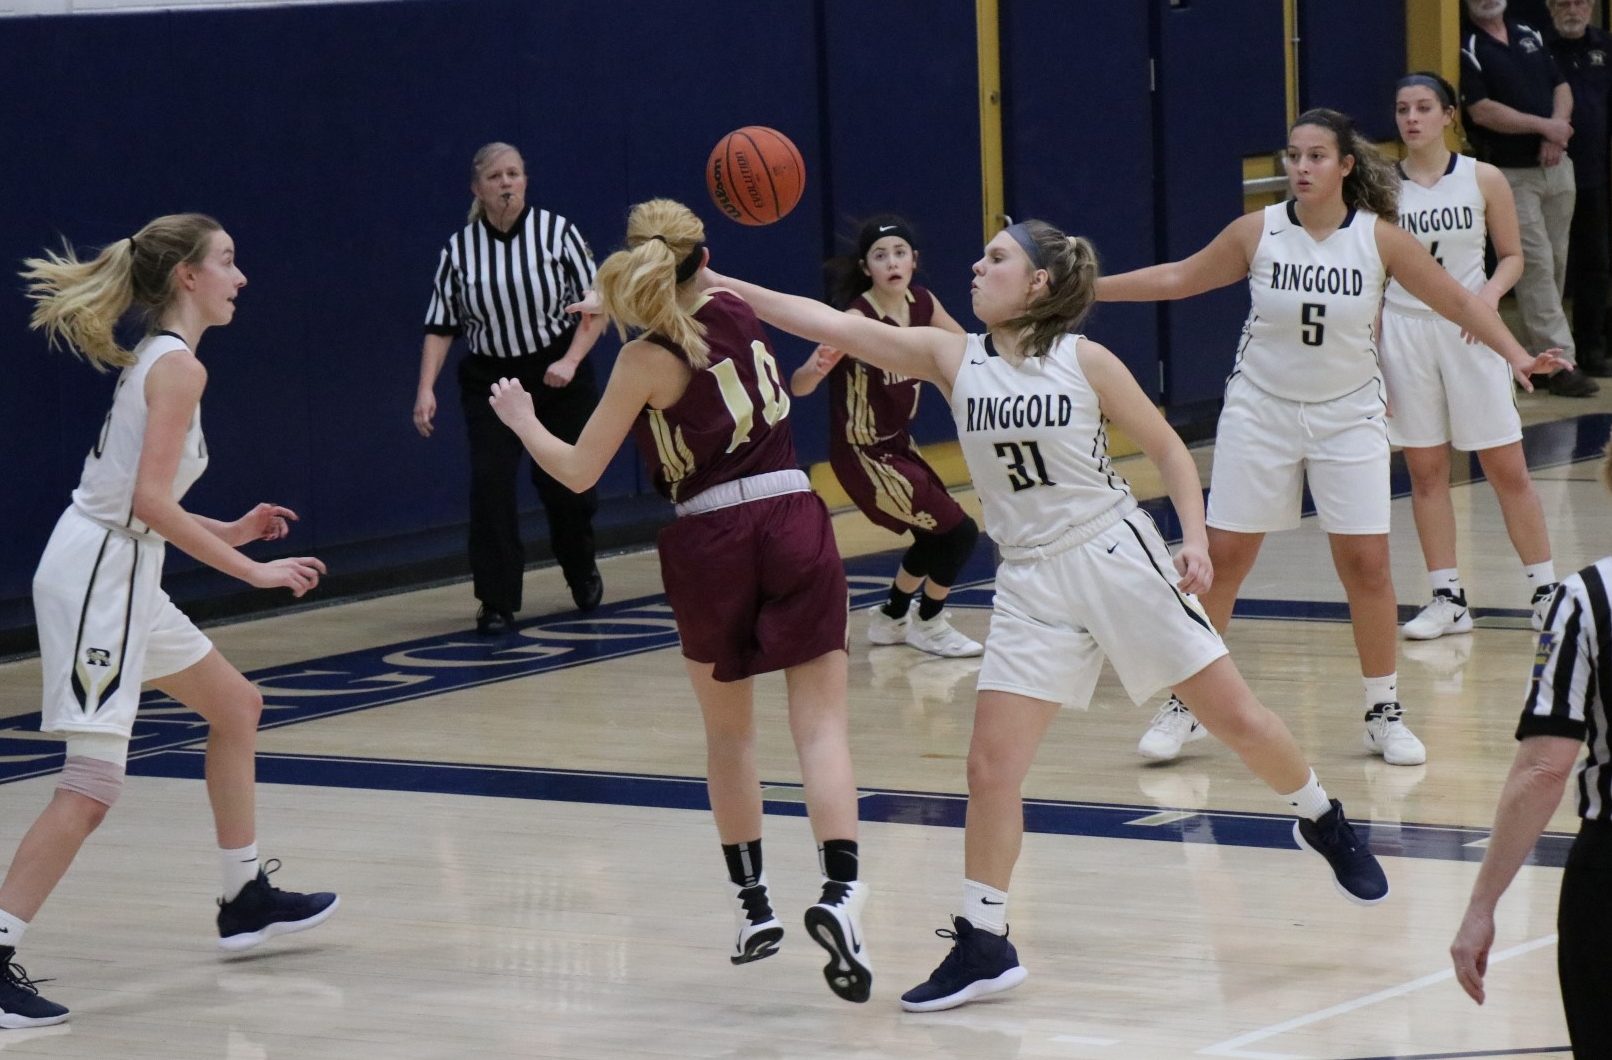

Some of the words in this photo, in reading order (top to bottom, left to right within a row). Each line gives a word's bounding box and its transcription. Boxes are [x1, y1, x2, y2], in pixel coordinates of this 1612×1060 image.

[714, 158, 742, 218] Wilson
[735, 151, 763, 208] EVOLUTION
[1401, 206, 1473, 235] INGGOLD
[1271, 261, 1363, 297] RINGGOLD
[1301, 302, 1327, 347] 5
[706, 339, 791, 454] 10
[966, 394, 1072, 432] RINGGOLD
[993, 441, 1057, 492] 31
